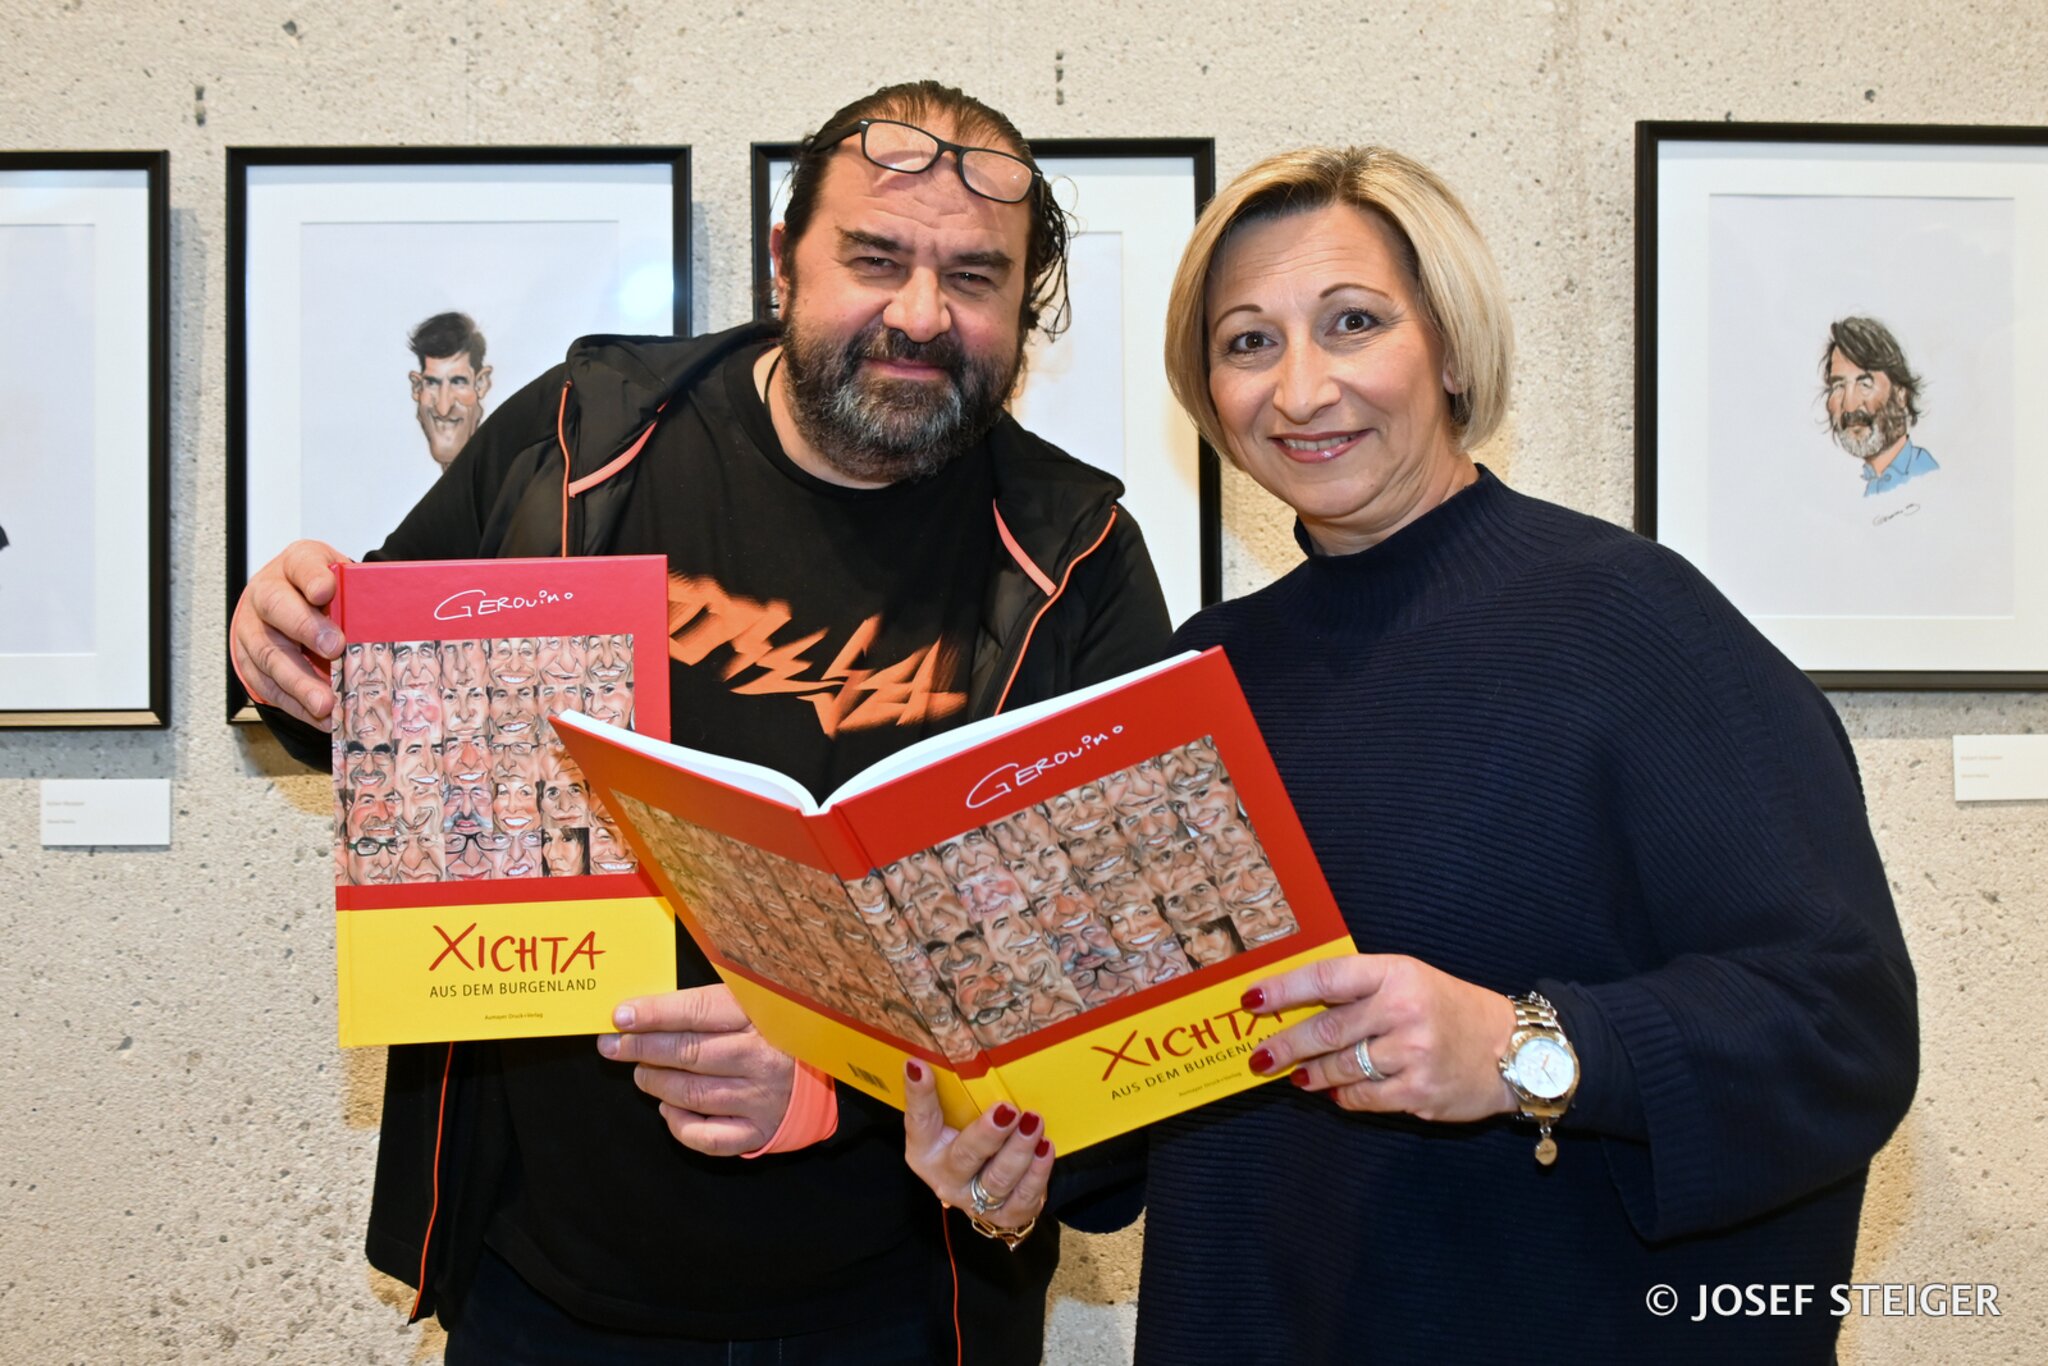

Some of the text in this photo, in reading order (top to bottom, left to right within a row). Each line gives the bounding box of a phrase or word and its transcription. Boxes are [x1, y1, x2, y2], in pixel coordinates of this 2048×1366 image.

[428, 922, 606, 975] XICHTA
[429, 977, 597, 998] AUS DEM BURGENLAND
[1111, 1082, 1141, 1101] AUS
[1144, 1068, 1180, 1088] DEM
[1184, 1032, 1277, 1074] BURGENL
